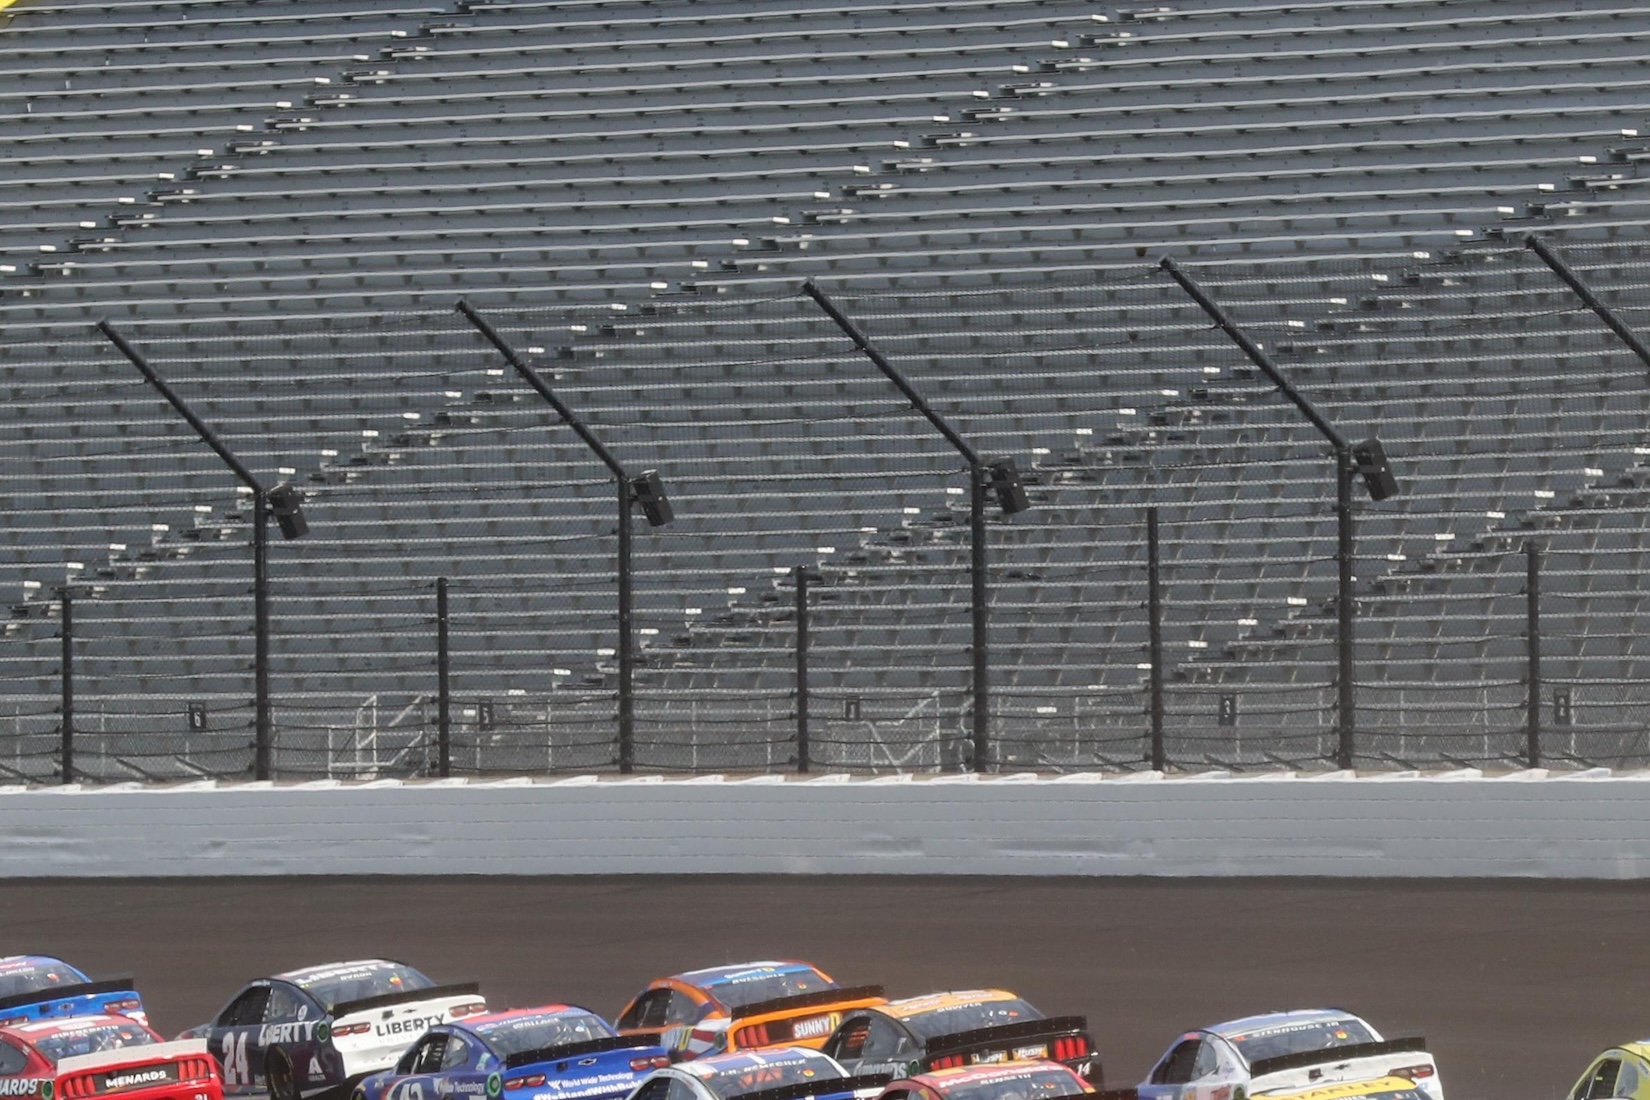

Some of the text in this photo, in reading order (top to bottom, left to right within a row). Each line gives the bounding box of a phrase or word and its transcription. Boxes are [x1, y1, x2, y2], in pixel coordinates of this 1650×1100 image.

[376, 1013, 446, 1037] LIBERTY
[221, 1030, 250, 1085] 24
[598, 1071, 634, 1085] Technology
[1077, 1062, 1092, 1077] 14
[0, 1078, 38, 1096] ARDS
[105, 1070, 167, 1088] MENARDS
